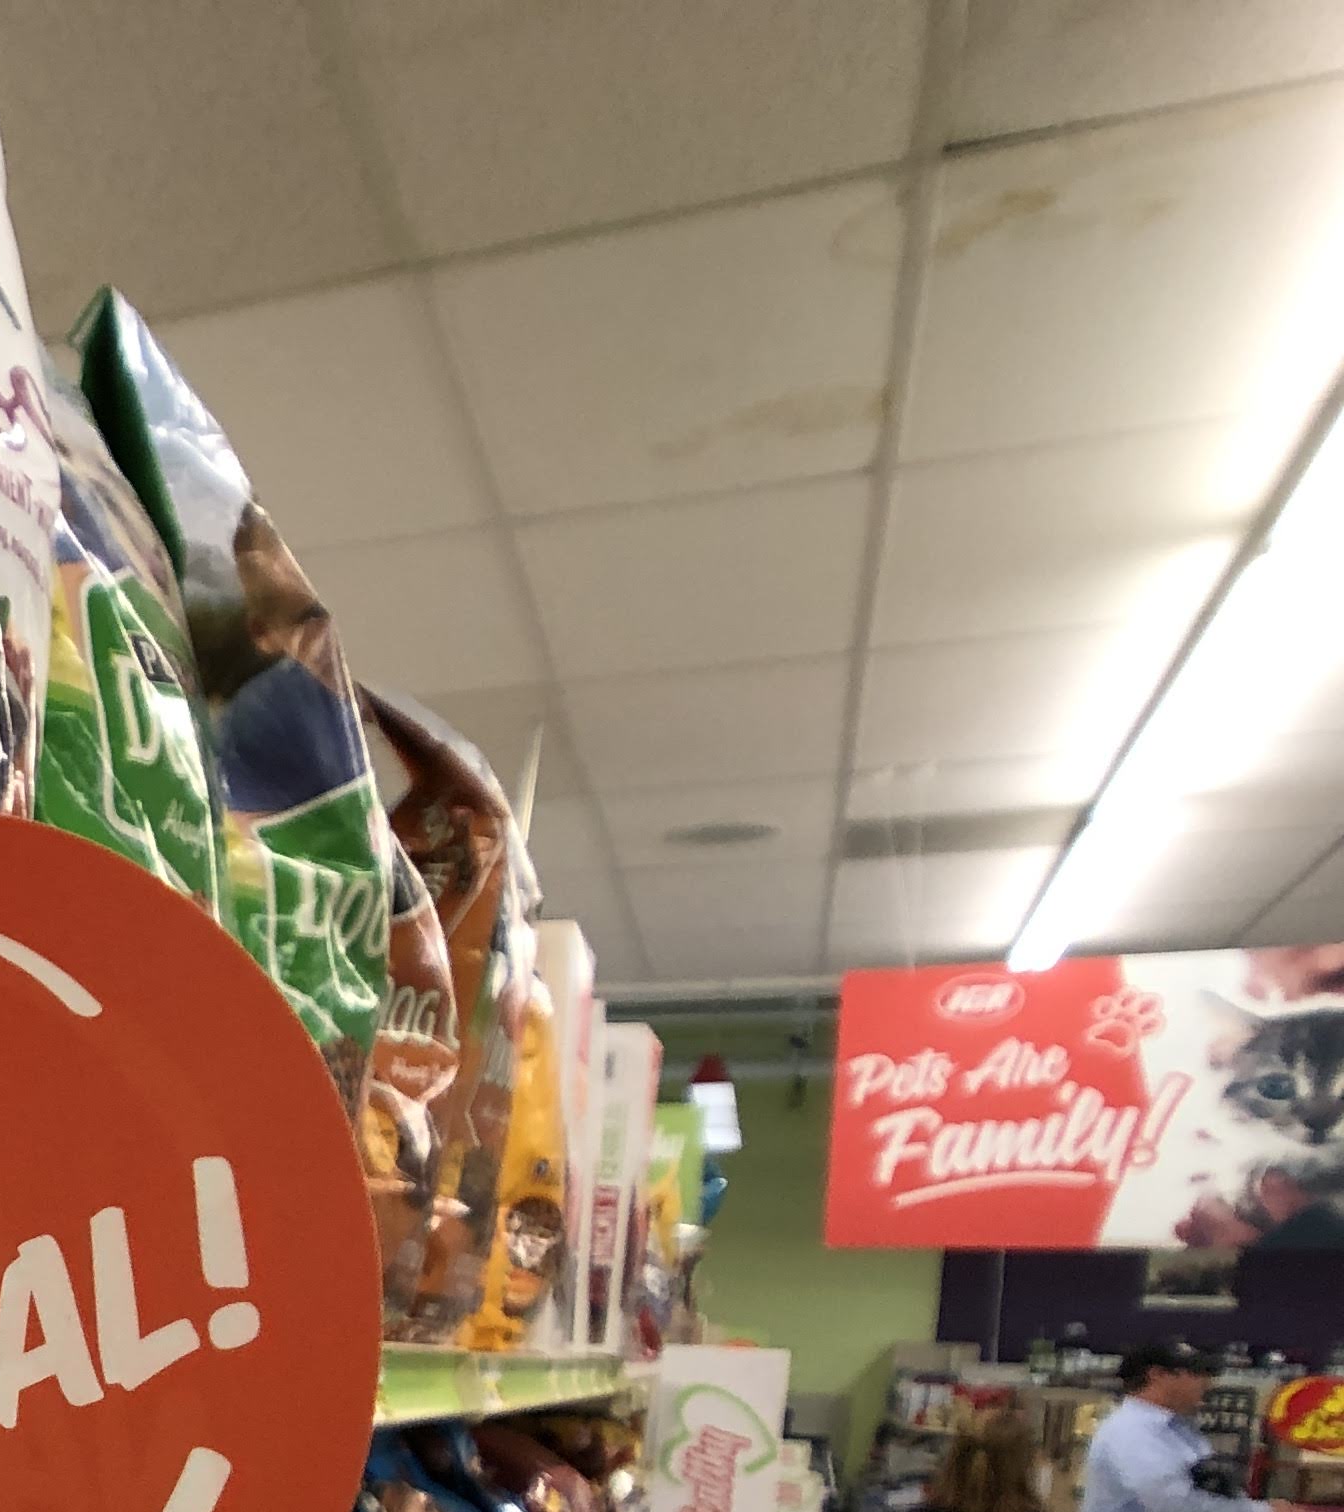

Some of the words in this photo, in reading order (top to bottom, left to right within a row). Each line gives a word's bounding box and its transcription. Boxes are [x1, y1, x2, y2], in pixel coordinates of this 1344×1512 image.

[849, 1048, 957, 1106] Pets
[964, 1036, 1069, 1097] Are
[874, 1072, 1195, 1187] Family!
